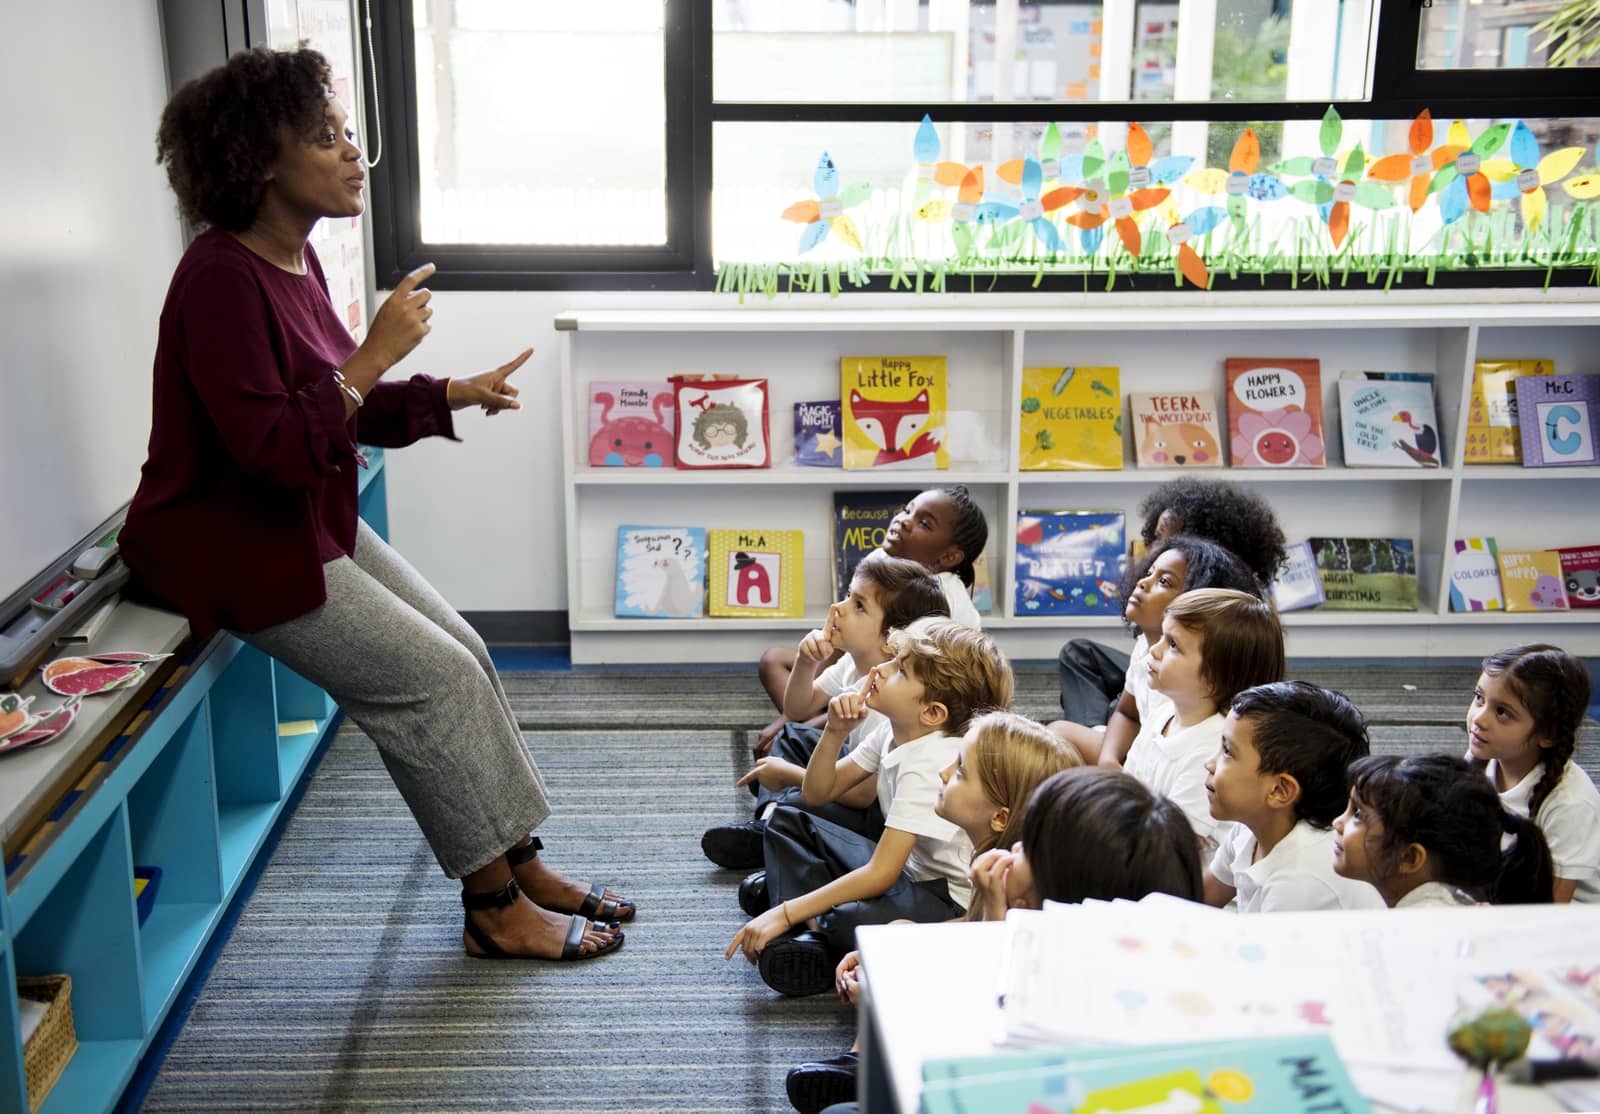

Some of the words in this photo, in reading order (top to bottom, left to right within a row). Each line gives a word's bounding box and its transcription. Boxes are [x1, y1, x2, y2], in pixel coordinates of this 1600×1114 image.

[881, 359, 911, 371] Happy
[858, 369, 902, 387] Little
[908, 371, 934, 387] Fox
[1247, 373, 1280, 387] HAPPY
[1246, 386, 1286, 400] FLOWER
[1288, 384, 1296, 396] 3
[620, 399, 648, 408] Monster
[1151, 396, 1201, 411] TEERA
[799, 405, 832, 417] MAGIC
[1043, 407, 1114, 420] VEGETABLES
[802, 415, 836, 426] NIGHT
[1195, 412, 1212, 423] CAT
[1324, 575, 1353, 585] NIGHT
[1325, 591, 1381, 601] CHRISTMAS
